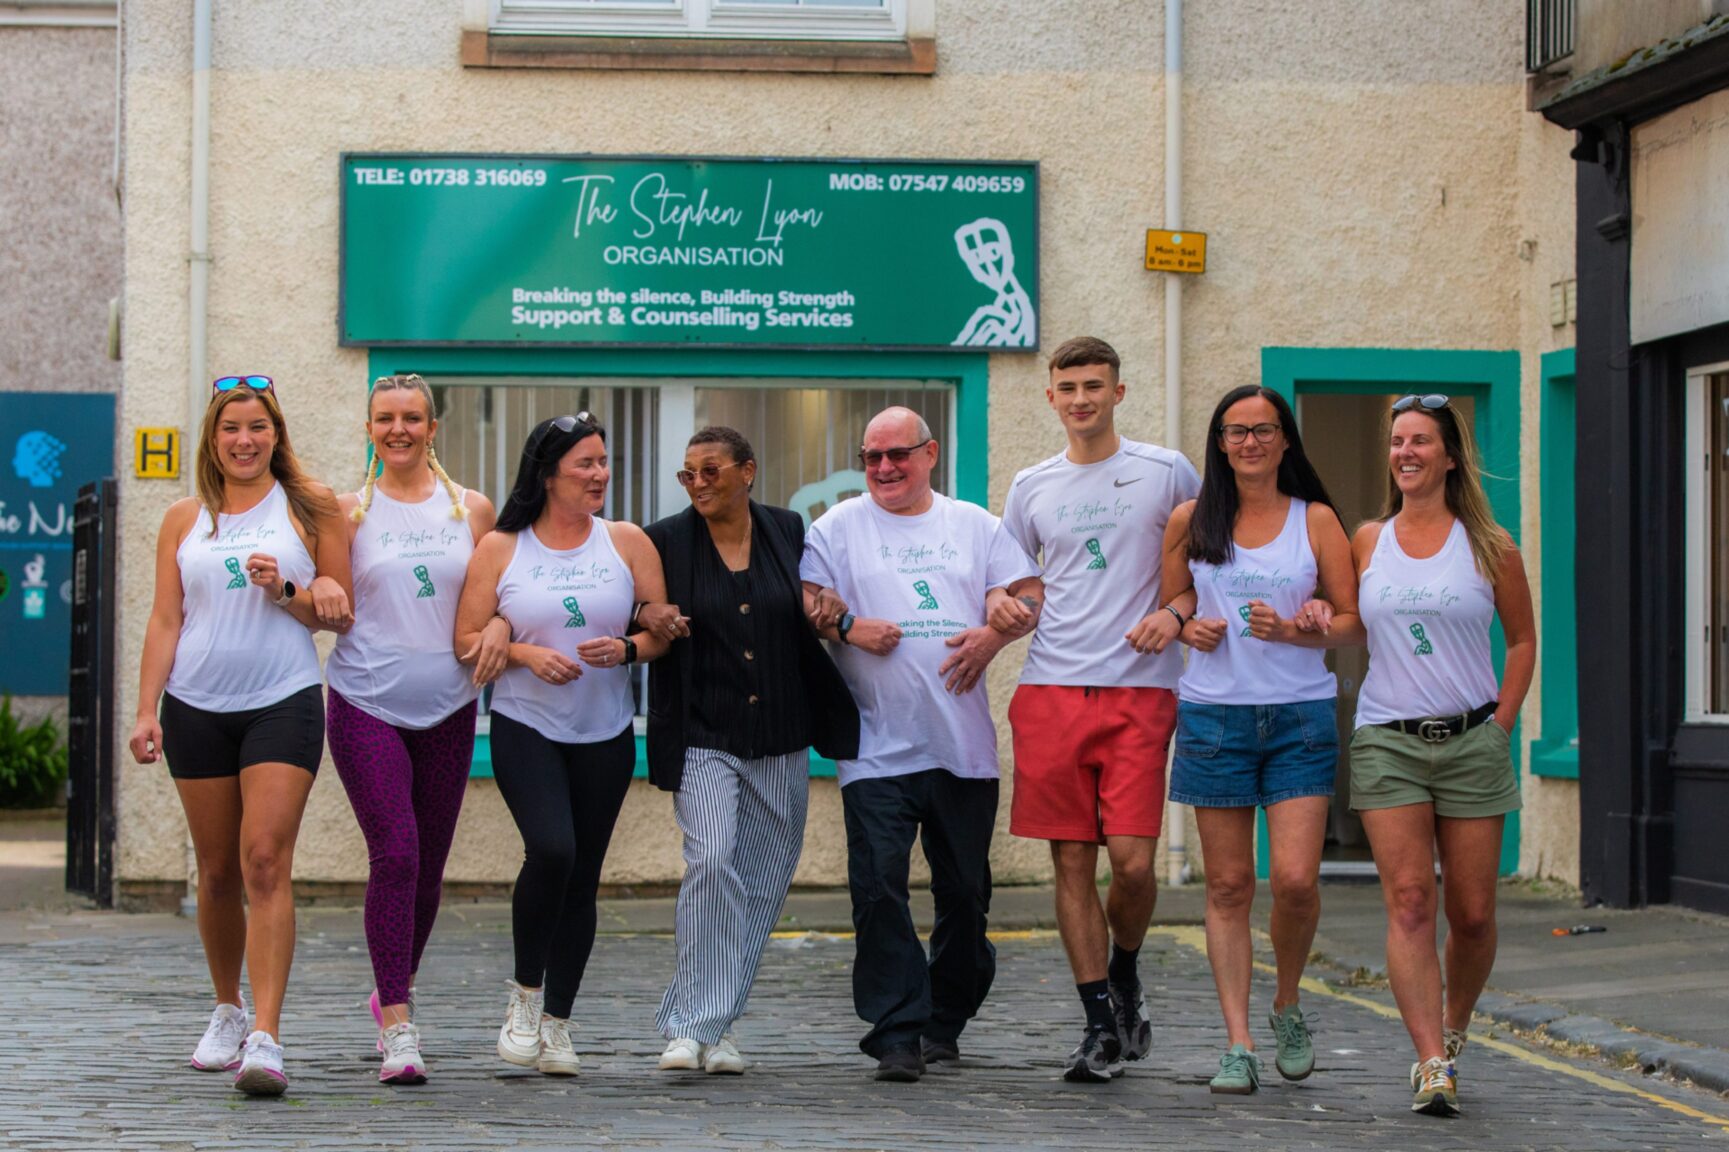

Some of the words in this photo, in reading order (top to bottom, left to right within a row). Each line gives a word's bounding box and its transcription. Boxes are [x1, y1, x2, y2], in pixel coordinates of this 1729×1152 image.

[354, 168, 405, 185] TELE:
[409, 168, 470, 186] 01738
[474, 169, 547, 187] 316069
[829, 173, 884, 191] MOB:
[889, 174, 949, 192] 07547
[951, 175, 1025, 193] 409659
[562, 174, 618, 239] The
[630, 172, 743, 242] Stephen
[755, 178, 823, 248] Lyon
[603, 245, 784, 266] ORGANISATION
[512, 286, 593, 307] Breaking
[595, 287, 627, 304] the
[630, 288, 696, 307] silence,
[700, 289, 774, 309] Building
[778, 290, 855, 310] Strength
[511, 305, 603, 329] Support
[607, 306, 626, 325] &
[630, 306, 760, 331] Counselling
[765, 307, 854, 328] Services
[141, 432, 173, 472] H
[1071, 522, 1118, 533] ORGANISATION
[210, 543, 258, 552] ORGANISATION
[398, 550, 446, 558] ORGANISATION
[897, 564, 946, 574] ORGANISATION
[547, 583, 597, 591] ORGANISATION
[1225, 591, 1273, 599] ORGANISATION
[1394, 608, 1441, 616] ORGANISATION
[926, 619, 941, 627] the
